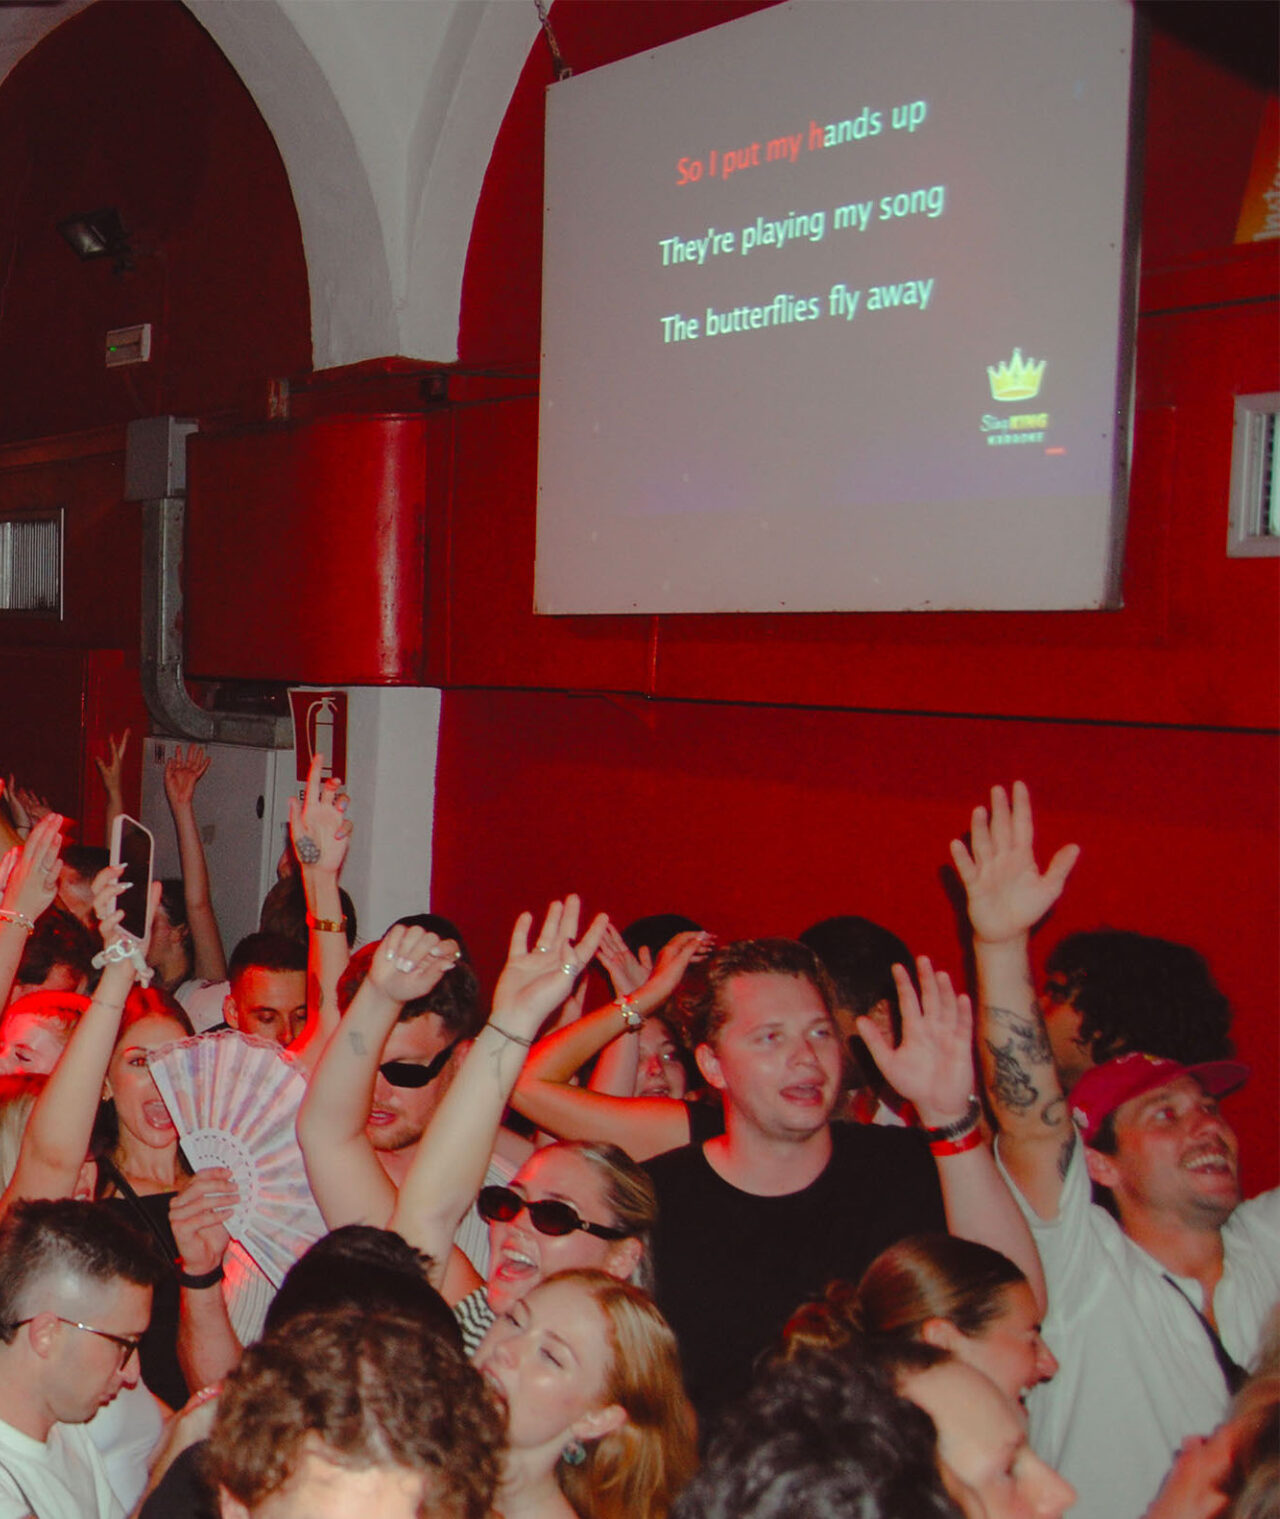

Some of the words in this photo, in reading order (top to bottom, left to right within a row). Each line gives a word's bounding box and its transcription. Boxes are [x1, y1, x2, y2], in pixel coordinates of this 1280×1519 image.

[676, 156, 703, 186] So
[709, 150, 717, 177] I
[722, 141, 760, 180] put
[766, 131, 803, 163] my
[809, 106, 883, 150] hands
[891, 99, 928, 132] up
[659, 228, 734, 267] They're
[741, 209, 825, 255] playing
[833, 199, 873, 231] my
[879, 184, 945, 219] song
[661, 314, 699, 344] The
[706, 294, 819, 337] butterflies
[828, 284, 860, 321] fly
[867, 278, 935, 310] away
